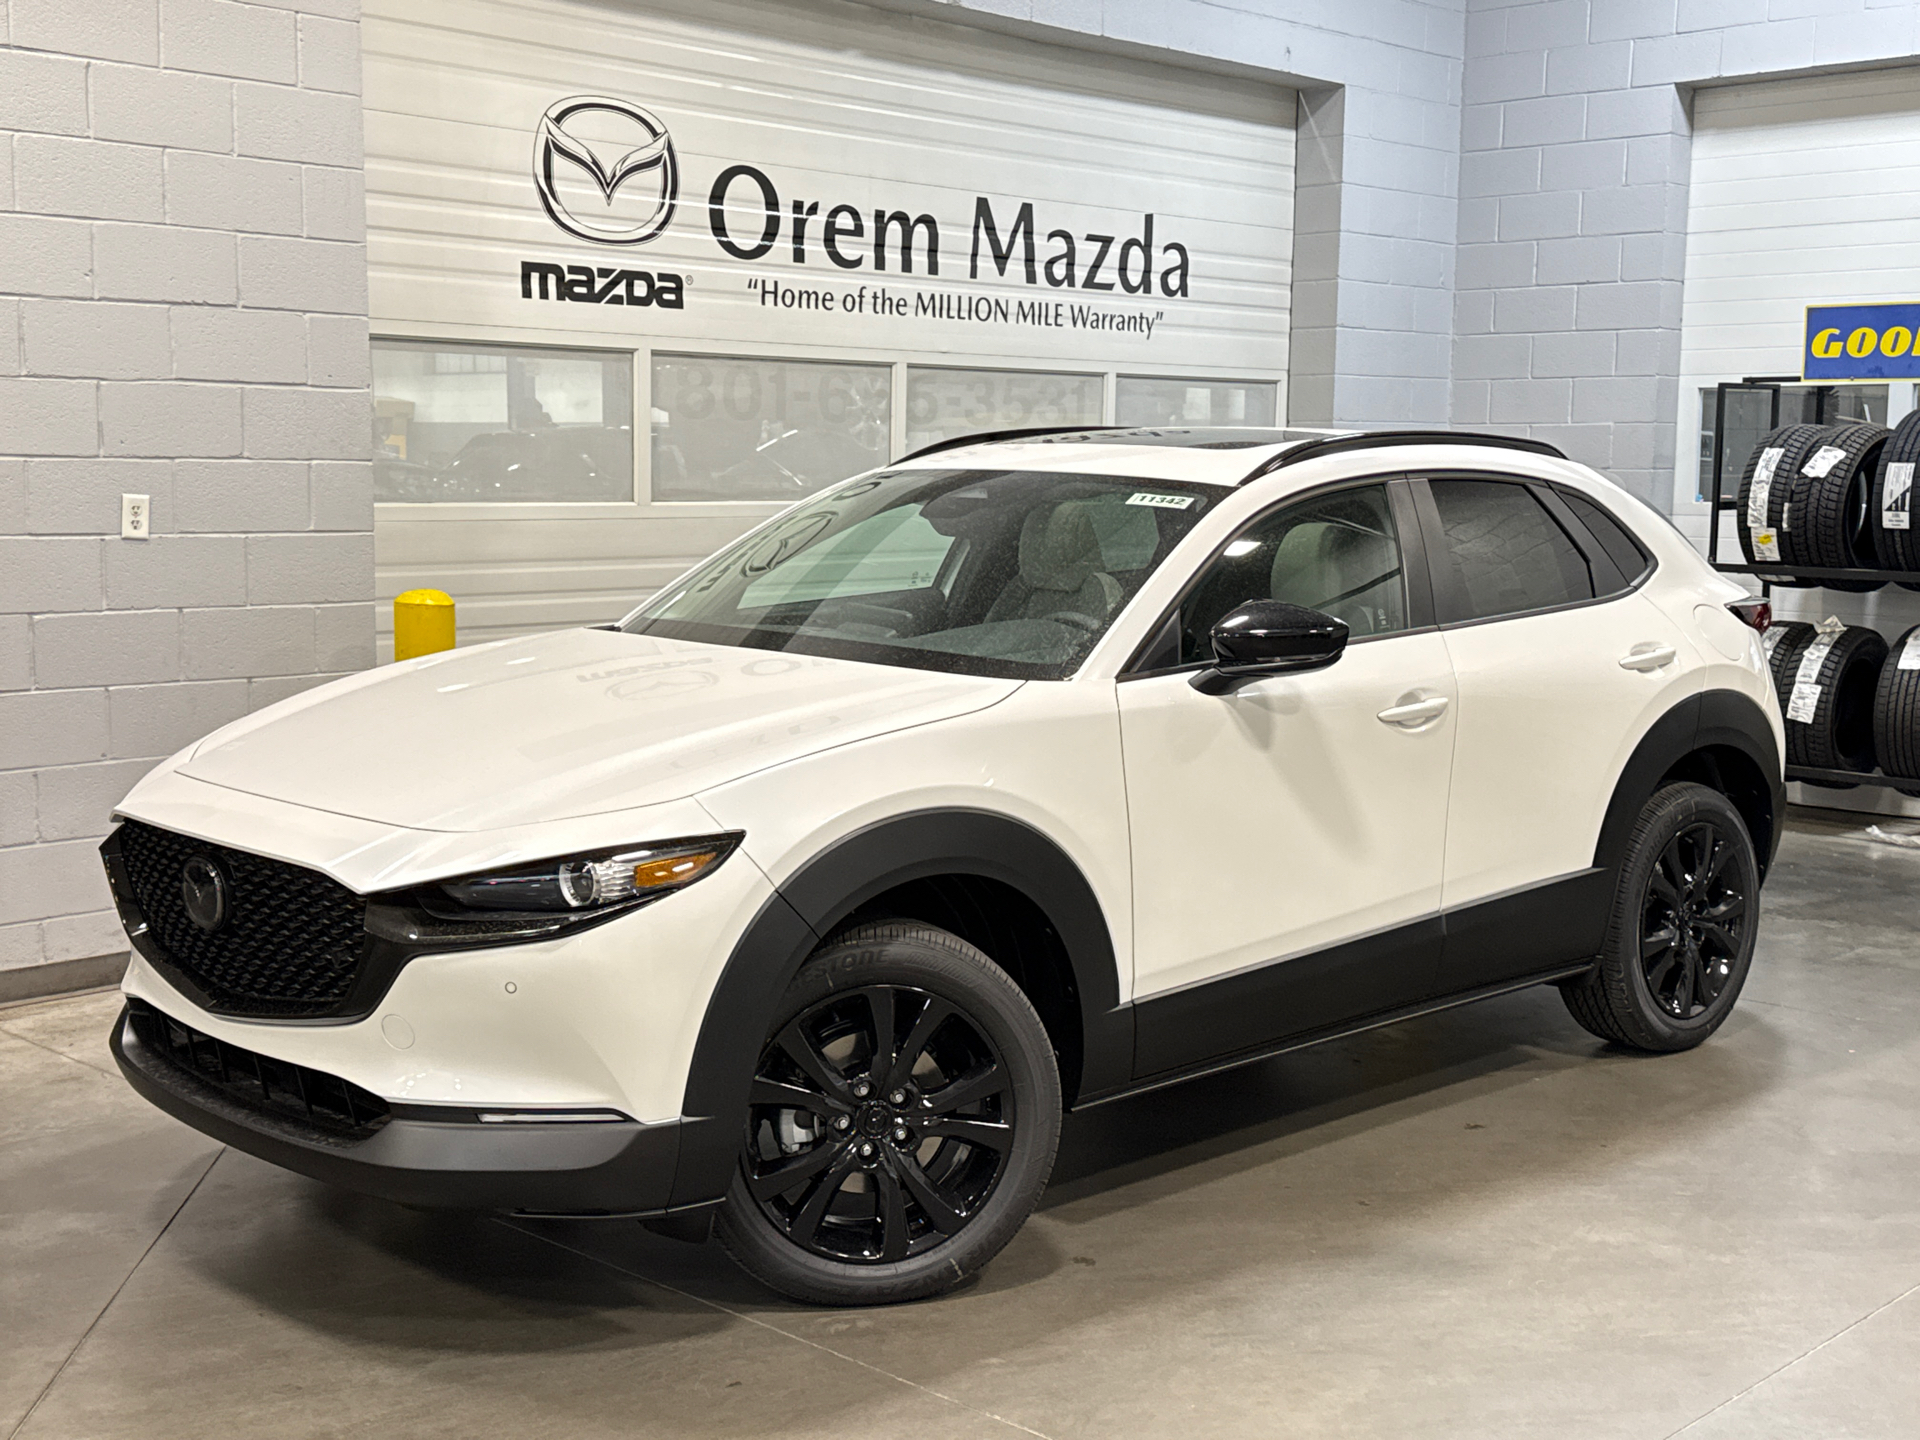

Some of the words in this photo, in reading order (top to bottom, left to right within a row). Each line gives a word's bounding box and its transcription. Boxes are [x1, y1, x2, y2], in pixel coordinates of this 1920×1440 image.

[708, 164, 939, 276] Orem
[969, 196, 1189, 298] Mazda
[842, 286, 867, 313] of
[872, 288, 908, 316] the
[915, 292, 1009, 323] MILLION
[1016, 300, 1064, 327] MILE
[1811, 326, 1920, 358] GOO
[1139, 495, 1187, 506] 11342
